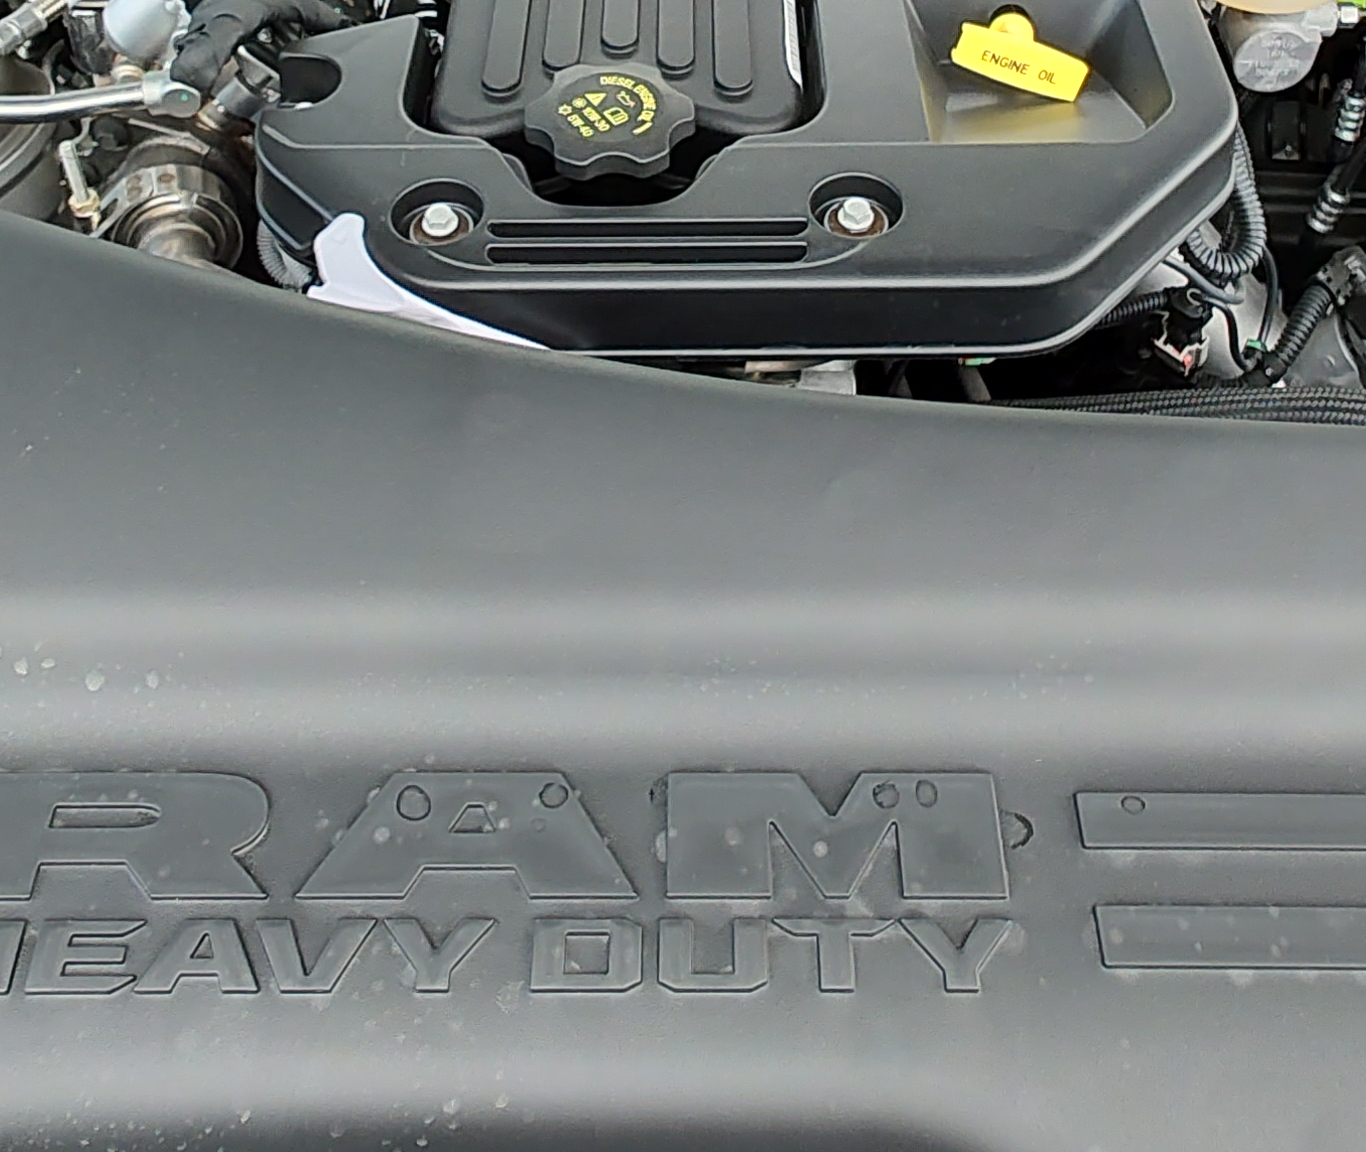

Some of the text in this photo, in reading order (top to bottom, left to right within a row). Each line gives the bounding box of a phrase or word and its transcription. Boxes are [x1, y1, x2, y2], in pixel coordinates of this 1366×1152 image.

[600, 75, 636, 90] DIESEL
[980, 49, 1057, 85] ENGINE OIL
[529, 916, 1013, 994] DUTY
